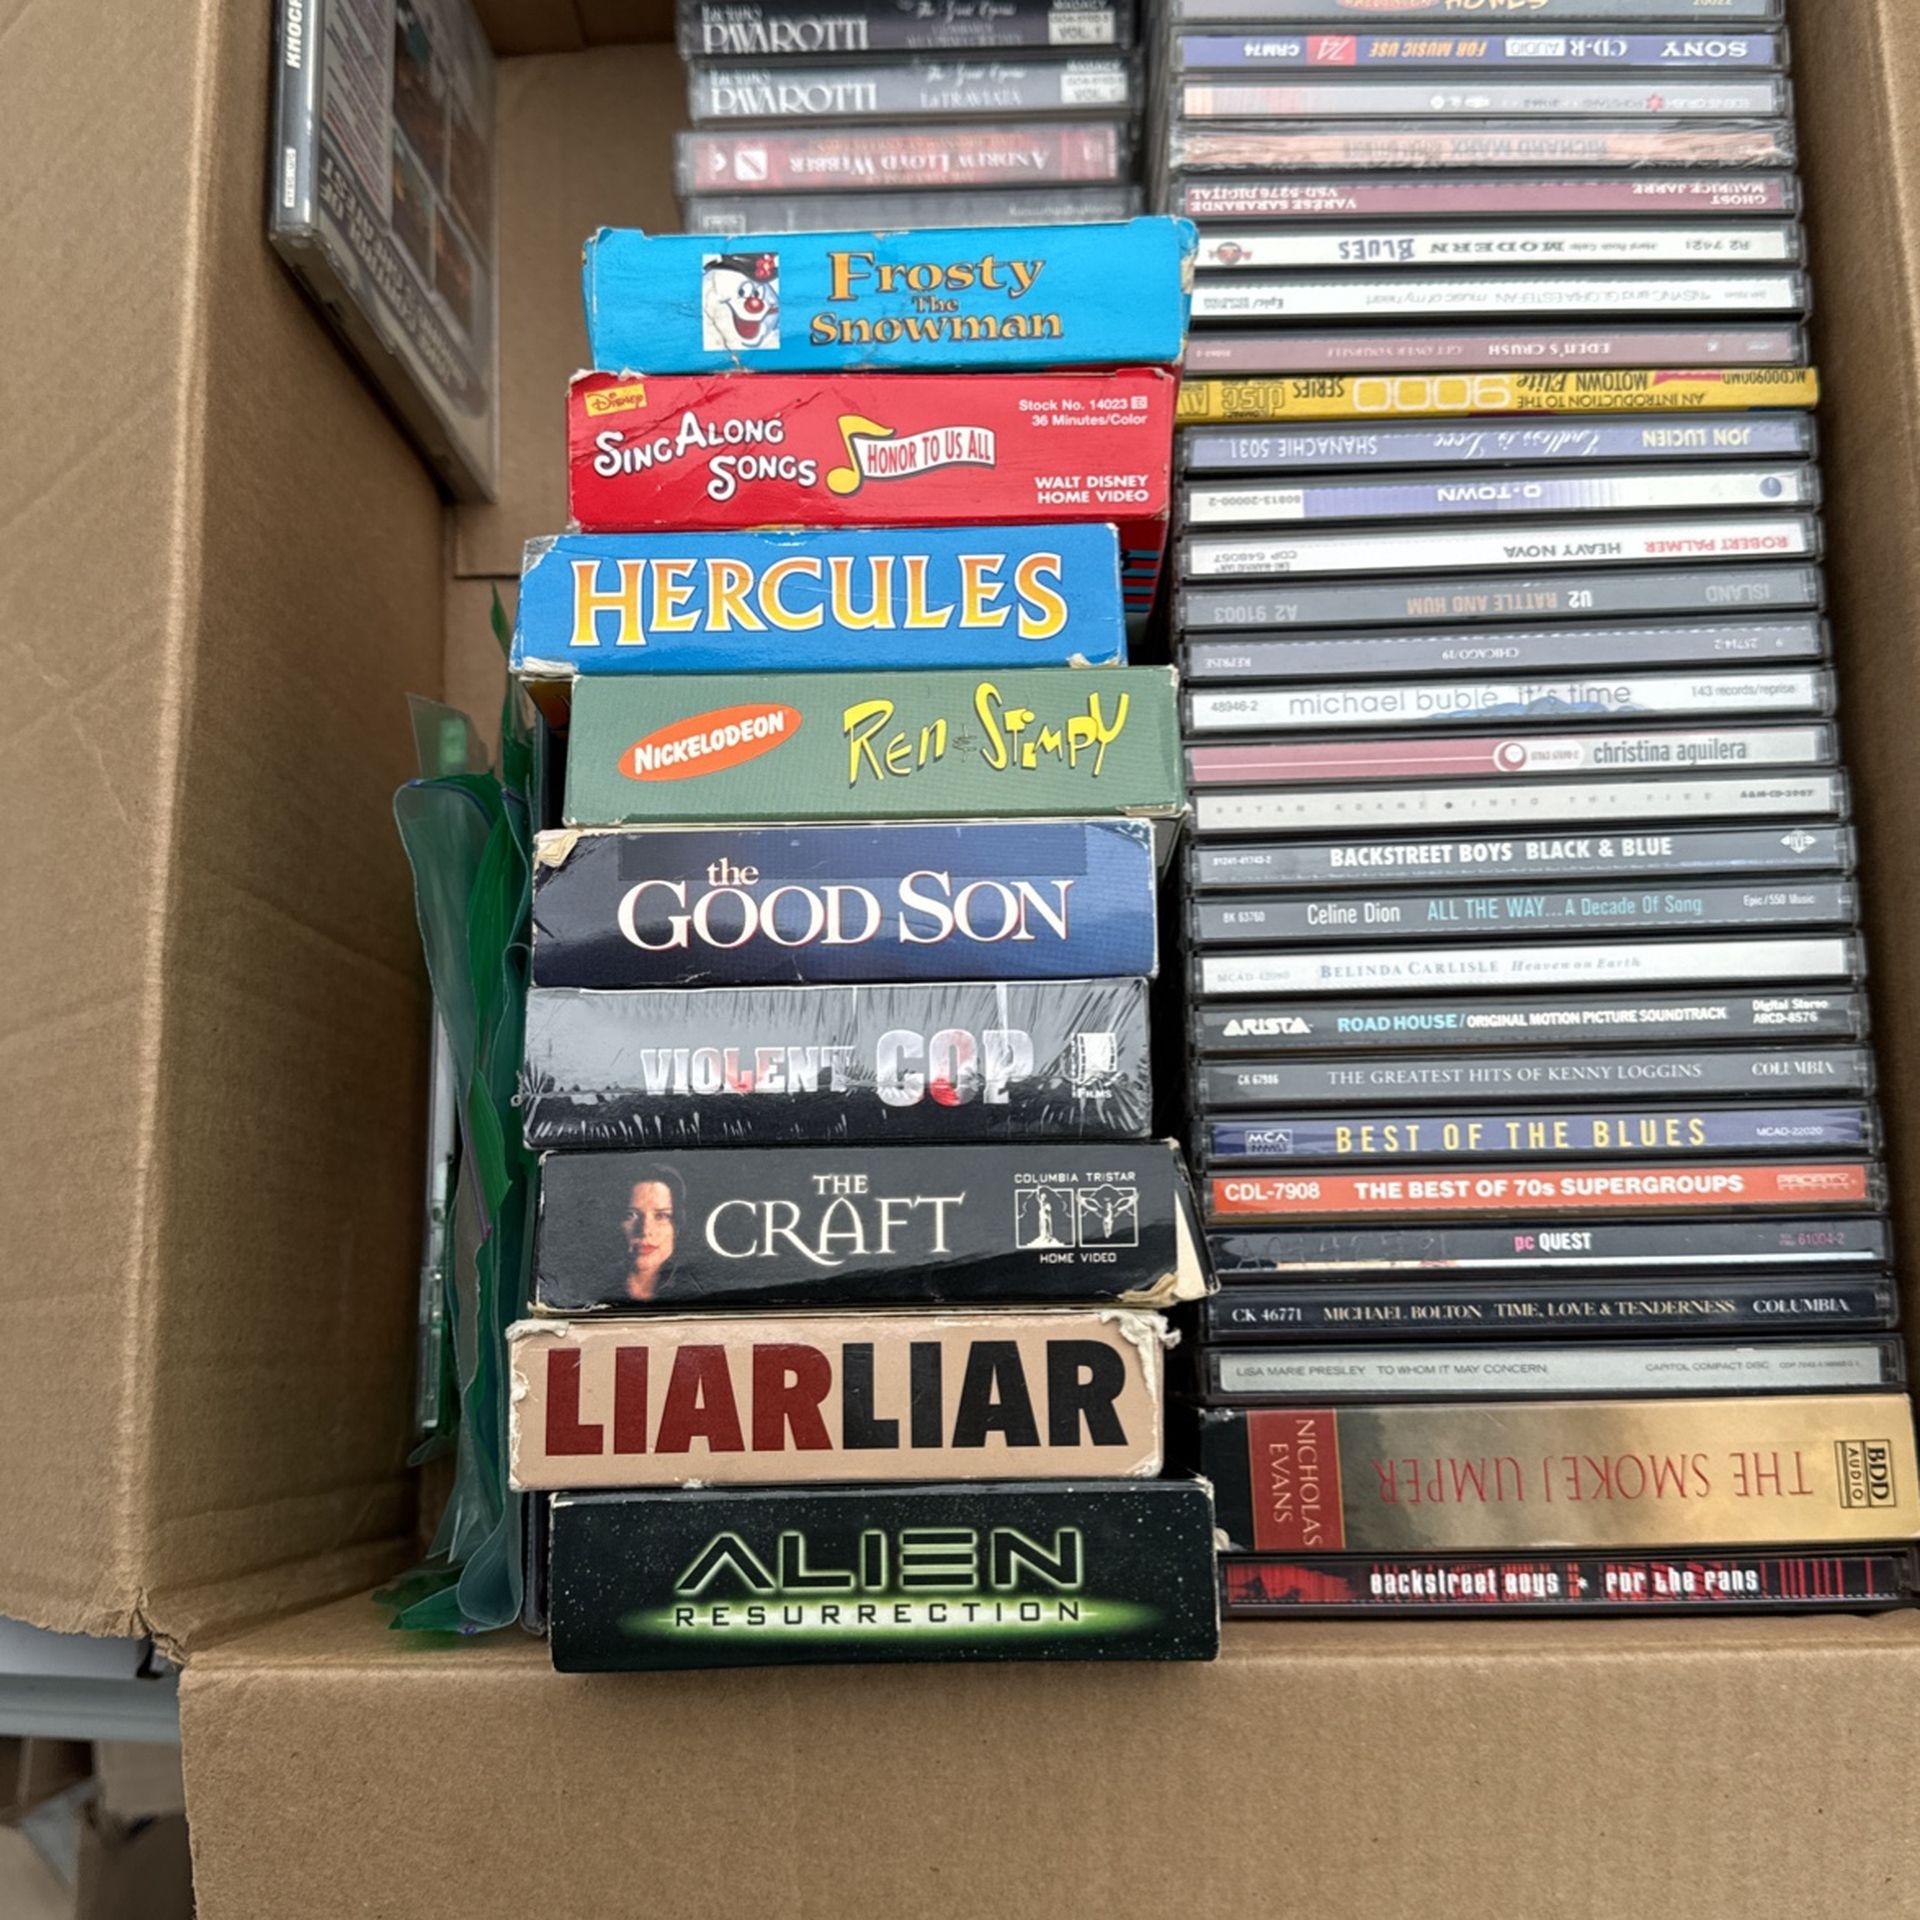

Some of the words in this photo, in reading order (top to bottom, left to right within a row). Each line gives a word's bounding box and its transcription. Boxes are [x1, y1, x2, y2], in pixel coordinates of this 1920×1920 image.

[703, 16, 868, 54] PAVAROTTI
[1243, 43, 1301, 57] CRM74
[1316, 38, 1350, 60] 74
[1368, 41, 1400, 57] USE
[1403, 41, 1453, 57] MUSIC
[1456, 40, 1488, 57] FOR
[1510, 40, 1562, 55] AUDIO
[1570, 39, 1627, 57] CD-R
[1660, 40, 1748, 57] SONY
[711, 82, 876, 114] PAVAROTTI
[1519, 139, 1608, 157] RICHARD
[790, 156, 875, 176] WEBBER
[880, 154, 951, 173] LLOYD
[959, 151, 1049, 170] ANDREW
[1631, 182, 1687, 194] JARRE
[1690, 182, 1765, 194] MAURICE
[1190, 199, 1289, 211] SARABANDE
[1710, 194, 1766, 205] GHOST
[1338, 239, 1415, 261] BLUES
[1429, 240, 1565, 253] MODERN
[826, 249, 1047, 302] Frosty
[911, 294, 960, 315] The
[810, 308, 1063, 346] Snowman
[1488, 344, 1545, 356] CRUSH
[1292, 377, 1345, 398] SERIES
[1516, 373, 1569, 392] Elite
[1575, 372, 1648, 389] MOTOWN
[588, 391, 646, 412] Disney
[1019, 399, 1058, 412] Stock
[1061, 398, 1085, 411] No.
[1089, 397, 1129, 410] 14023
[1516, 395, 1543, 408] THE
[1545, 395, 1565, 407] TO
[1569, 393, 1678, 407] INTRODUCTION
[1681, 392, 1704, 404] AN
[1032, 415, 1049, 427] 36
[1051, 413, 1148, 427] Minutes/Color
[922, 434, 941, 463] TO
[944, 430, 964, 460] US
[1277, 437, 1379, 456] SHANACHIE
[1433, 433, 1488, 459] Love
[1523, 430, 1600, 455] Endless
[1642, 430, 1707, 446] LUCIEN
[1712, 429, 1751, 445] JON
[1230, 439, 1270, 457] 5031
[1035, 476, 1082, 489] WALT
[1086, 474, 1149, 488] DISNEY
[1038, 491, 1090, 504] HOME
[1095, 490, 1150, 503] VIDEO
[1503, 544, 1557, 558] NOVA
[1563, 542, 1621, 556] HEAVY
[1644, 540, 1716, 553] PALMER
[1720, 536, 1789, 550] ROBERT
[568, 551, 1069, 648] HERCULES
[1492, 592, 1557, 610] RATTLE
[1568, 590, 1593, 608] U2
[1705, 584, 1770, 602] ISLAND
[1407, 598, 1447, 615] HUM
[1452, 595, 1488, 613] AND
[1289, 691, 1406, 715] michael
[1415, 684, 1499, 711] bublé
[1518, 683, 1557, 703] it's
[1567, 683, 1632, 703] time
[633, 710, 786, 774] NICKELODEON
[842, 697, 948, 788] Ren
[1593, 739, 1671, 764] christina
[1676, 737, 1748, 766] aguilera
[1329, 844, 1455, 867] BACKSTREET
[1458, 842, 1514, 863] BOYS
[1525, 839, 1591, 861] BLACK
[1597, 838, 1615, 858] &
[1621, 836, 1674, 857] BLUE
[706, 857, 760, 887] the
[616, 878, 882, 951] GOOD
[898, 869, 1075, 943] SON
[1307, 903, 1358, 925] Celine
[1363, 902, 1401, 923] Dion
[1427, 900, 1460, 921] ALL
[1464, 898, 1499, 919] THE
[1581, 897, 1636, 916] Decade
[1642, 896, 1658, 913] Of
[1665, 894, 1702, 916] Song
[1320, 965, 1402, 980] BELINDA
[1407, 960, 1498, 977] CARLISLE
[1752, 999, 1789, 1012] Digital
[1791, 998, 1829, 1010] Stereo
[1222, 1017, 1311, 1036] ARISTA
[1337, 1015, 1392, 1033] ROAD
[1529, 1010, 1581, 1026] MOTION
[1582, 1008, 1638, 1025] PICTURE
[1639, 1006, 1728, 1022] SOUNDTRACK
[640, 1045, 856, 1096] VIOLENT
[876, 1028, 1035, 1107] COP
[1327, 1071, 1364, 1085] THE
[1370, 1068, 1464, 1083] GREATEST
[1469, 1067, 1512, 1082] HITS
[1517, 1066, 1542, 1081] OF
[1549, 1065, 1613, 1081] KENNY
[1617, 1063, 1703, 1080] LOGGINS
[1752, 1061, 1835, 1076] COLUMBIA
[1248, 1132, 1289, 1143] MCA
[1335, 1125, 1420, 1153] BEST
[1442, 1123, 1483, 1150] OF
[1506, 1120, 1569, 1149] THE
[1592, 1117, 1706, 1149] BLUES
[813, 1173, 868, 1195] THE
[1014, 1173, 1078, 1184] COLUMBIA
[1085, 1171, 1136, 1182] TRISTAR
[1224, 1182, 1321, 1201] CDL-7908
[1354, 1182, 1403, 1199] THE
[1408, 1180, 1471, 1198] BEST
[1475, 1179, 1509, 1197] OF
[1513, 1178, 1555, 1197] 70s
[1560, 1174, 1744, 1196] SUPERGROUPS
[704, 1190, 967, 1266] CRAFT
[1538, 1232, 1592, 1253] QUEST
[1040, 1253, 1074, 1264] HOME
[1080, 1252, 1117, 1263] VIDEO
[1231, 1308, 1257, 1322] CK
[1261, 1306, 1302, 1322] 46771
[1323, 1306, 1404, 1321] MICHAEL
[1411, 1305, 1482, 1320] BOLTON
[1494, 1302, 1543, 1318] TIME,
[1548, 1301, 1598, 1316] LOVE
[1600, 1302, 1612, 1316] &
[1617, 1300, 1736, 1316] TENDERNESS
[1753, 1298, 1850, 1314] COLUMBIA
[1236, 1366, 1265, 1377] LISA
[1267, 1366, 1306, 1376] MARIE
[1308, 1365, 1366, 1376] PRESLEY
[1377, 1365, 1394, 1375] TO
[1397, 1365, 1436, 1375] WHOM
[1438, 1364, 1450, 1374] IT
[1453, 1364, 1479, 1375] MAY
[1483, 1364, 1547, 1374] CONCERN
[1268, 1442, 1293, 1523] EVANS
[1295, 1418, 1323, 1547] NICHOLAS
[1730, 1451, 1814, 1497] THE
[1846, 1447, 1864, 1501] AUDIO
[1866, 1446, 1891, 1501] BDD
[675, 1526, 1084, 1593] ALIEN
[675, 1600, 1082, 1629] RESURRECTION
